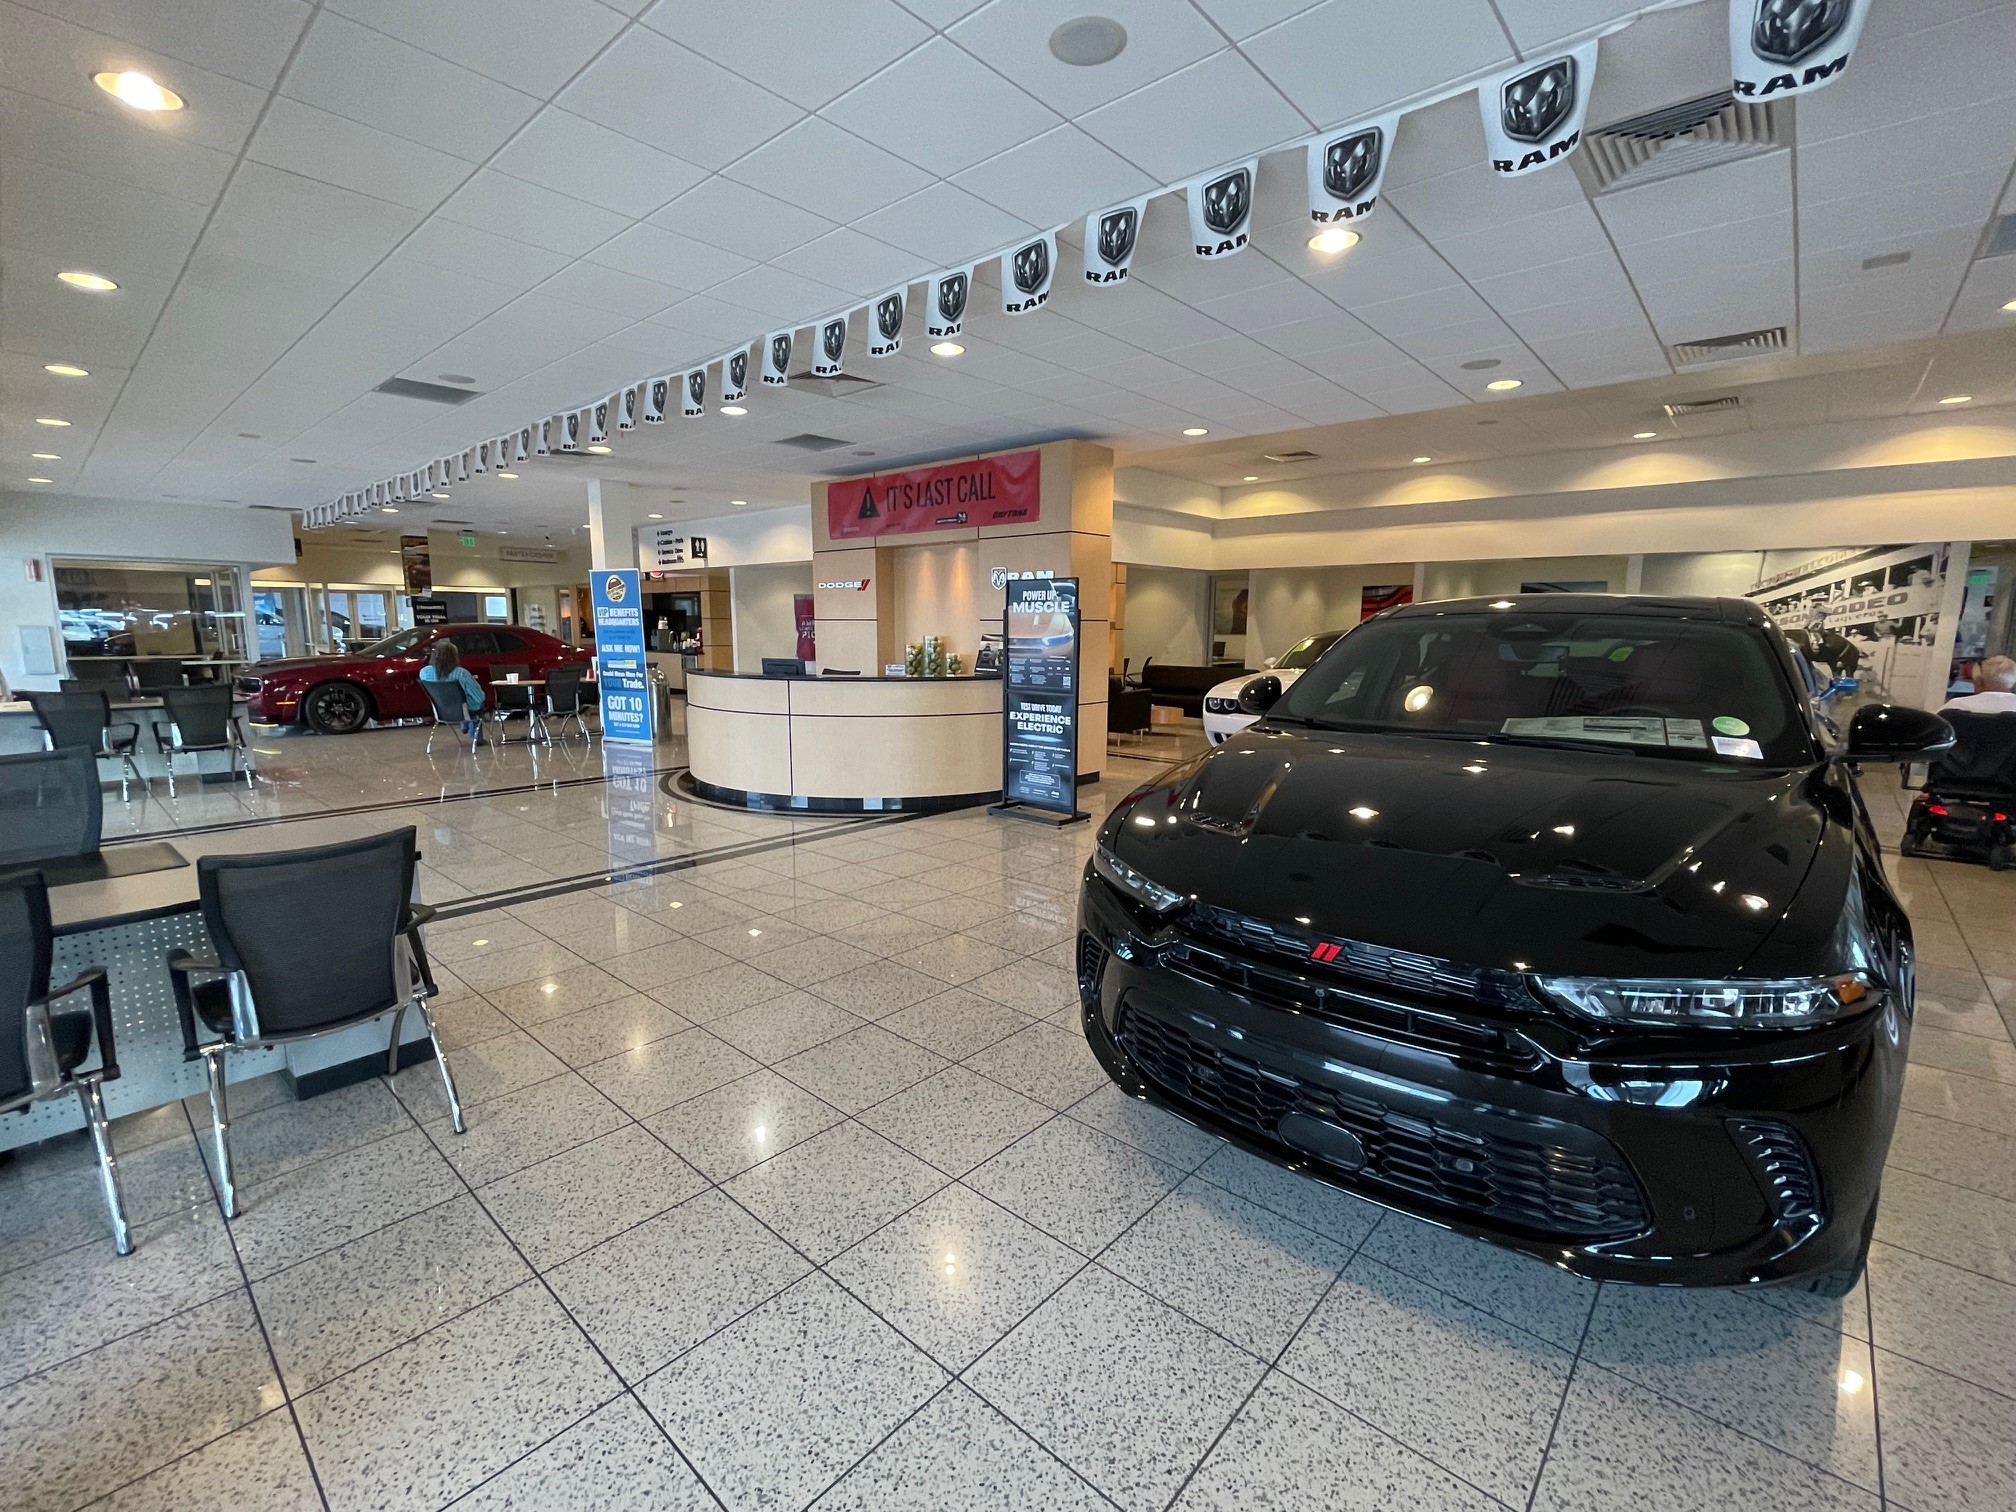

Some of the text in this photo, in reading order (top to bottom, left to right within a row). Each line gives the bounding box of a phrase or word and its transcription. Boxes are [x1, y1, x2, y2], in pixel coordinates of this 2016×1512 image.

[1733, 52, 1850, 97] RAM
[1493, 129, 1580, 173] RAM
[1311, 196, 1377, 223] RAM
[1195, 233, 1249, 256] RAM
[1006, 290, 1050, 312] RAM
[871, 340, 899, 355] RA
[815, 364, 842, 374] RA
[763, 375, 785, 384] RA
[725, 391, 747, 401] RA
[685, 407, 703, 416] RA
[645, 414, 663, 422] RA
[886, 472, 996, 512] IT'S LAST CALL
[992, 509, 1028, 519] DAYTONA
[1007, 570, 1054, 581] RAM
[818, 581, 862, 589] DODGE
[1022, 590, 1046, 601] POWER
[1012, 601, 1070, 613] MUSCLE
[1833, 592, 1909, 616] ODEO
[609, 608, 639, 618] BENEFITS
[597, 617, 640, 627] HEADQUARTERS
[601, 643, 613, 653] ASK
[613, 643, 624, 653] ME
[622, 677, 645, 690] Trade.
[607, 695, 643, 712] GOT 10
[1031, 703, 1046, 712] DRIVE
[1046, 704, 1062, 713] TODAY
[608, 711, 644, 723] MINUTES?
[1009, 711, 1071, 725] EXPERIENCE
[1017, 721, 1064, 734] ELECTRIC
